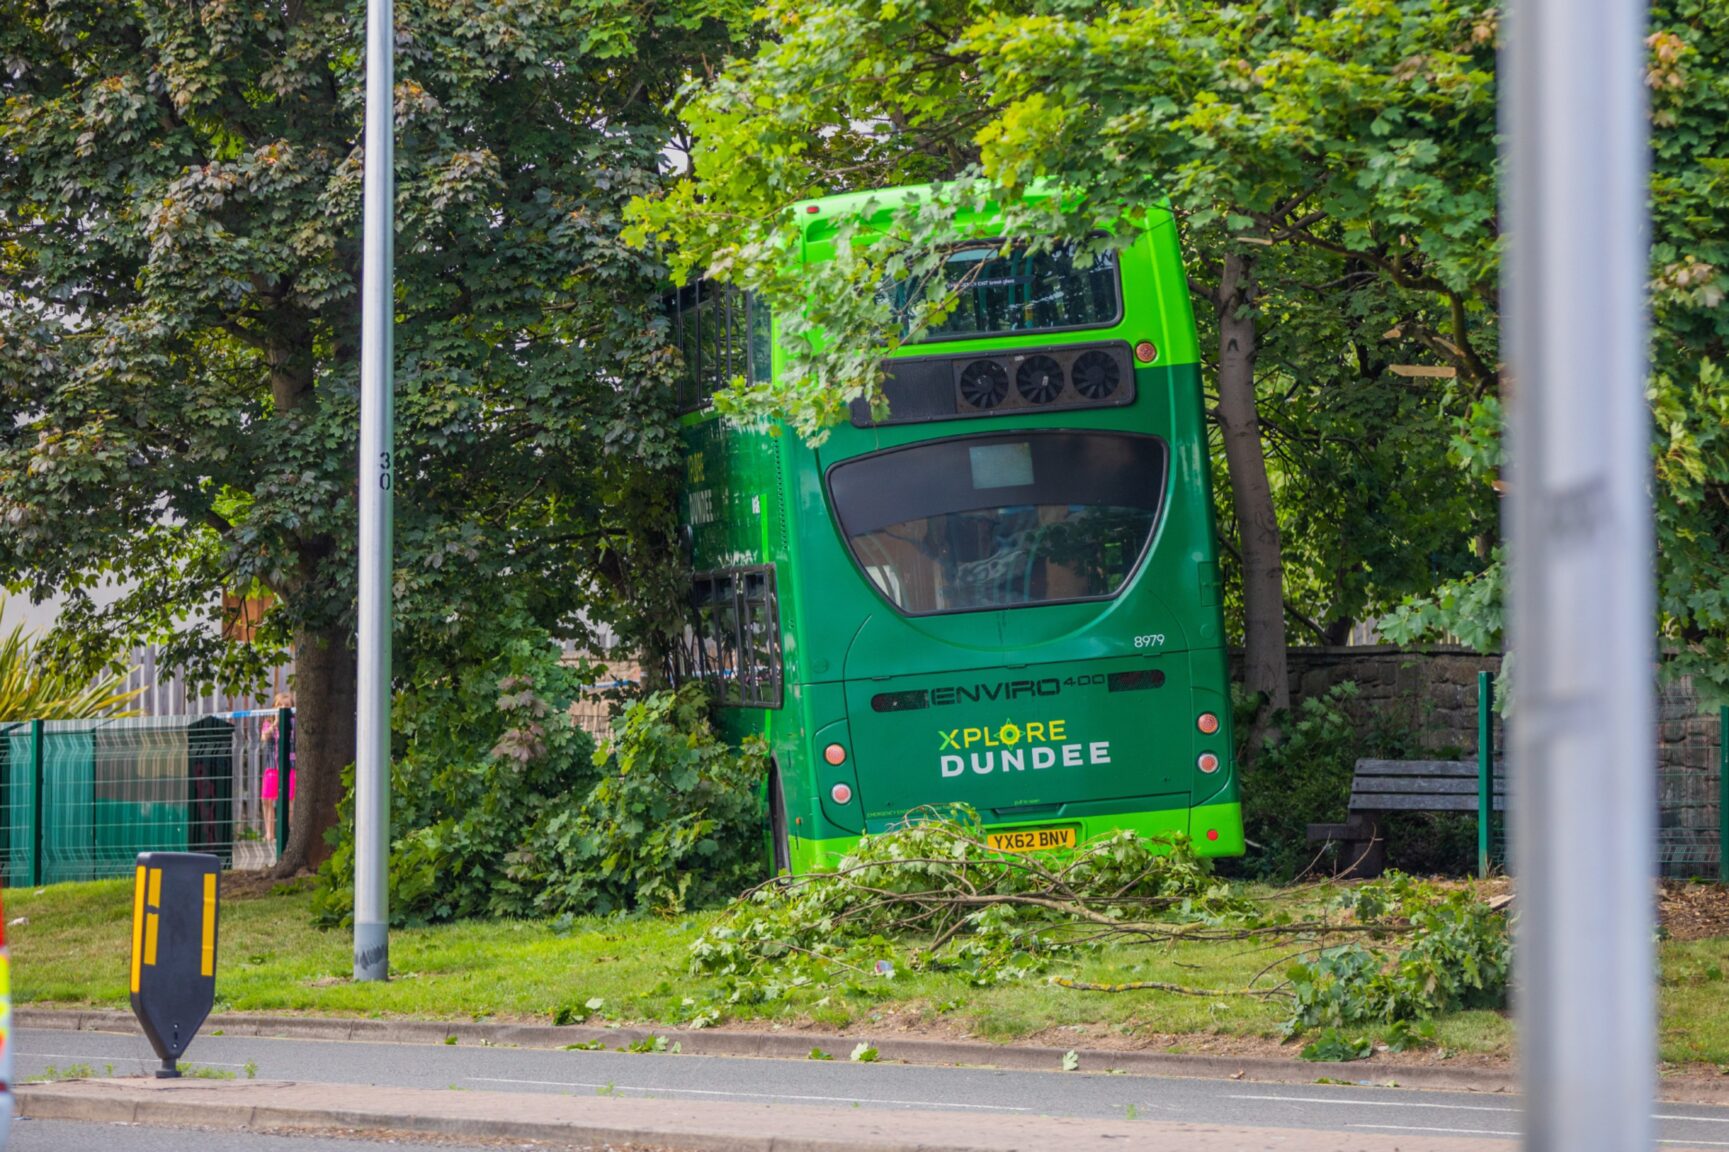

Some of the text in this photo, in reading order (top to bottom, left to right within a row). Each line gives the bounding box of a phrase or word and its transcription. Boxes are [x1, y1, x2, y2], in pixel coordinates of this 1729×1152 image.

[380, 452, 390, 490] 30
[1134, 634, 1165, 648] 8979
[931, 673, 1105, 706] ENVIRO 400
[938, 718, 1067, 751] XPLORE
[940, 741, 1111, 778] DUNDEE
[994, 830, 1069, 850] YX62 BNV
